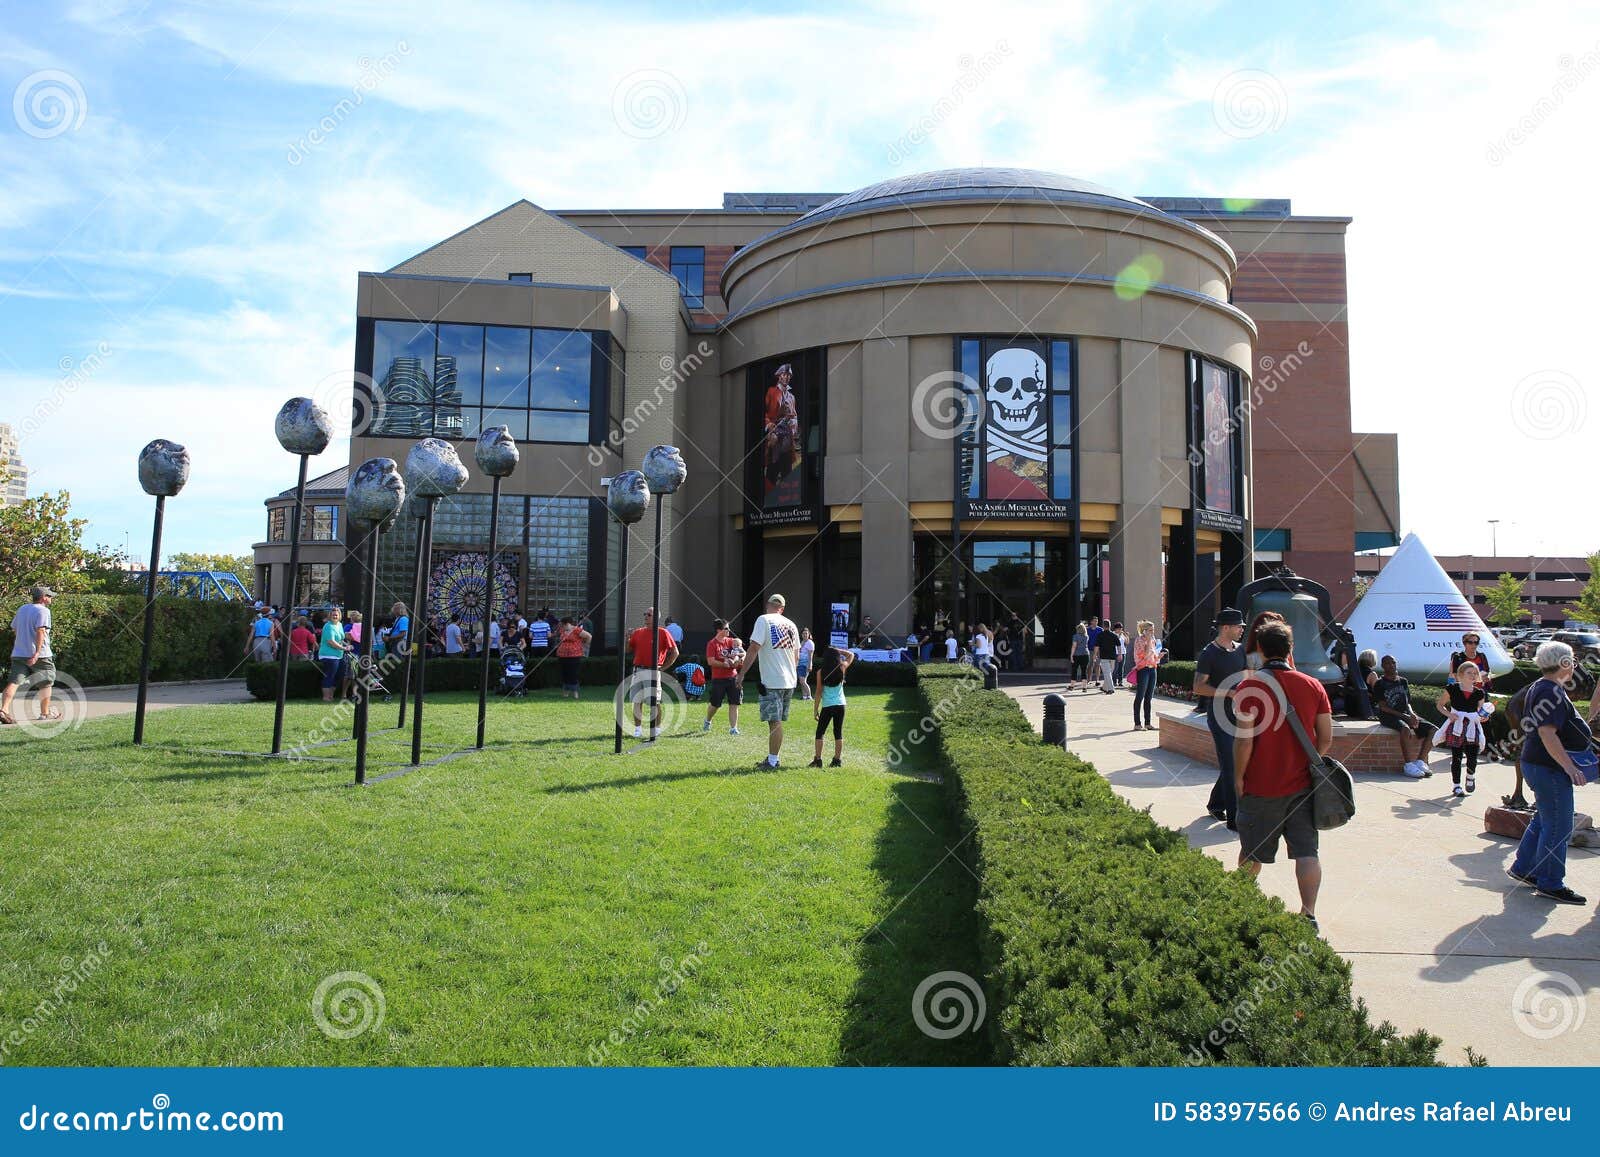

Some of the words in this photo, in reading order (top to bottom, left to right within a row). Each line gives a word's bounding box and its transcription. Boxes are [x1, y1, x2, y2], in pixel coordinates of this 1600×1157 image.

[969, 503, 983, 511] VAN
[984, 503, 1007, 511] ANDEL
[1008, 503, 1038, 511] MUSEUM
[1039, 503, 1067, 511] CENTER
